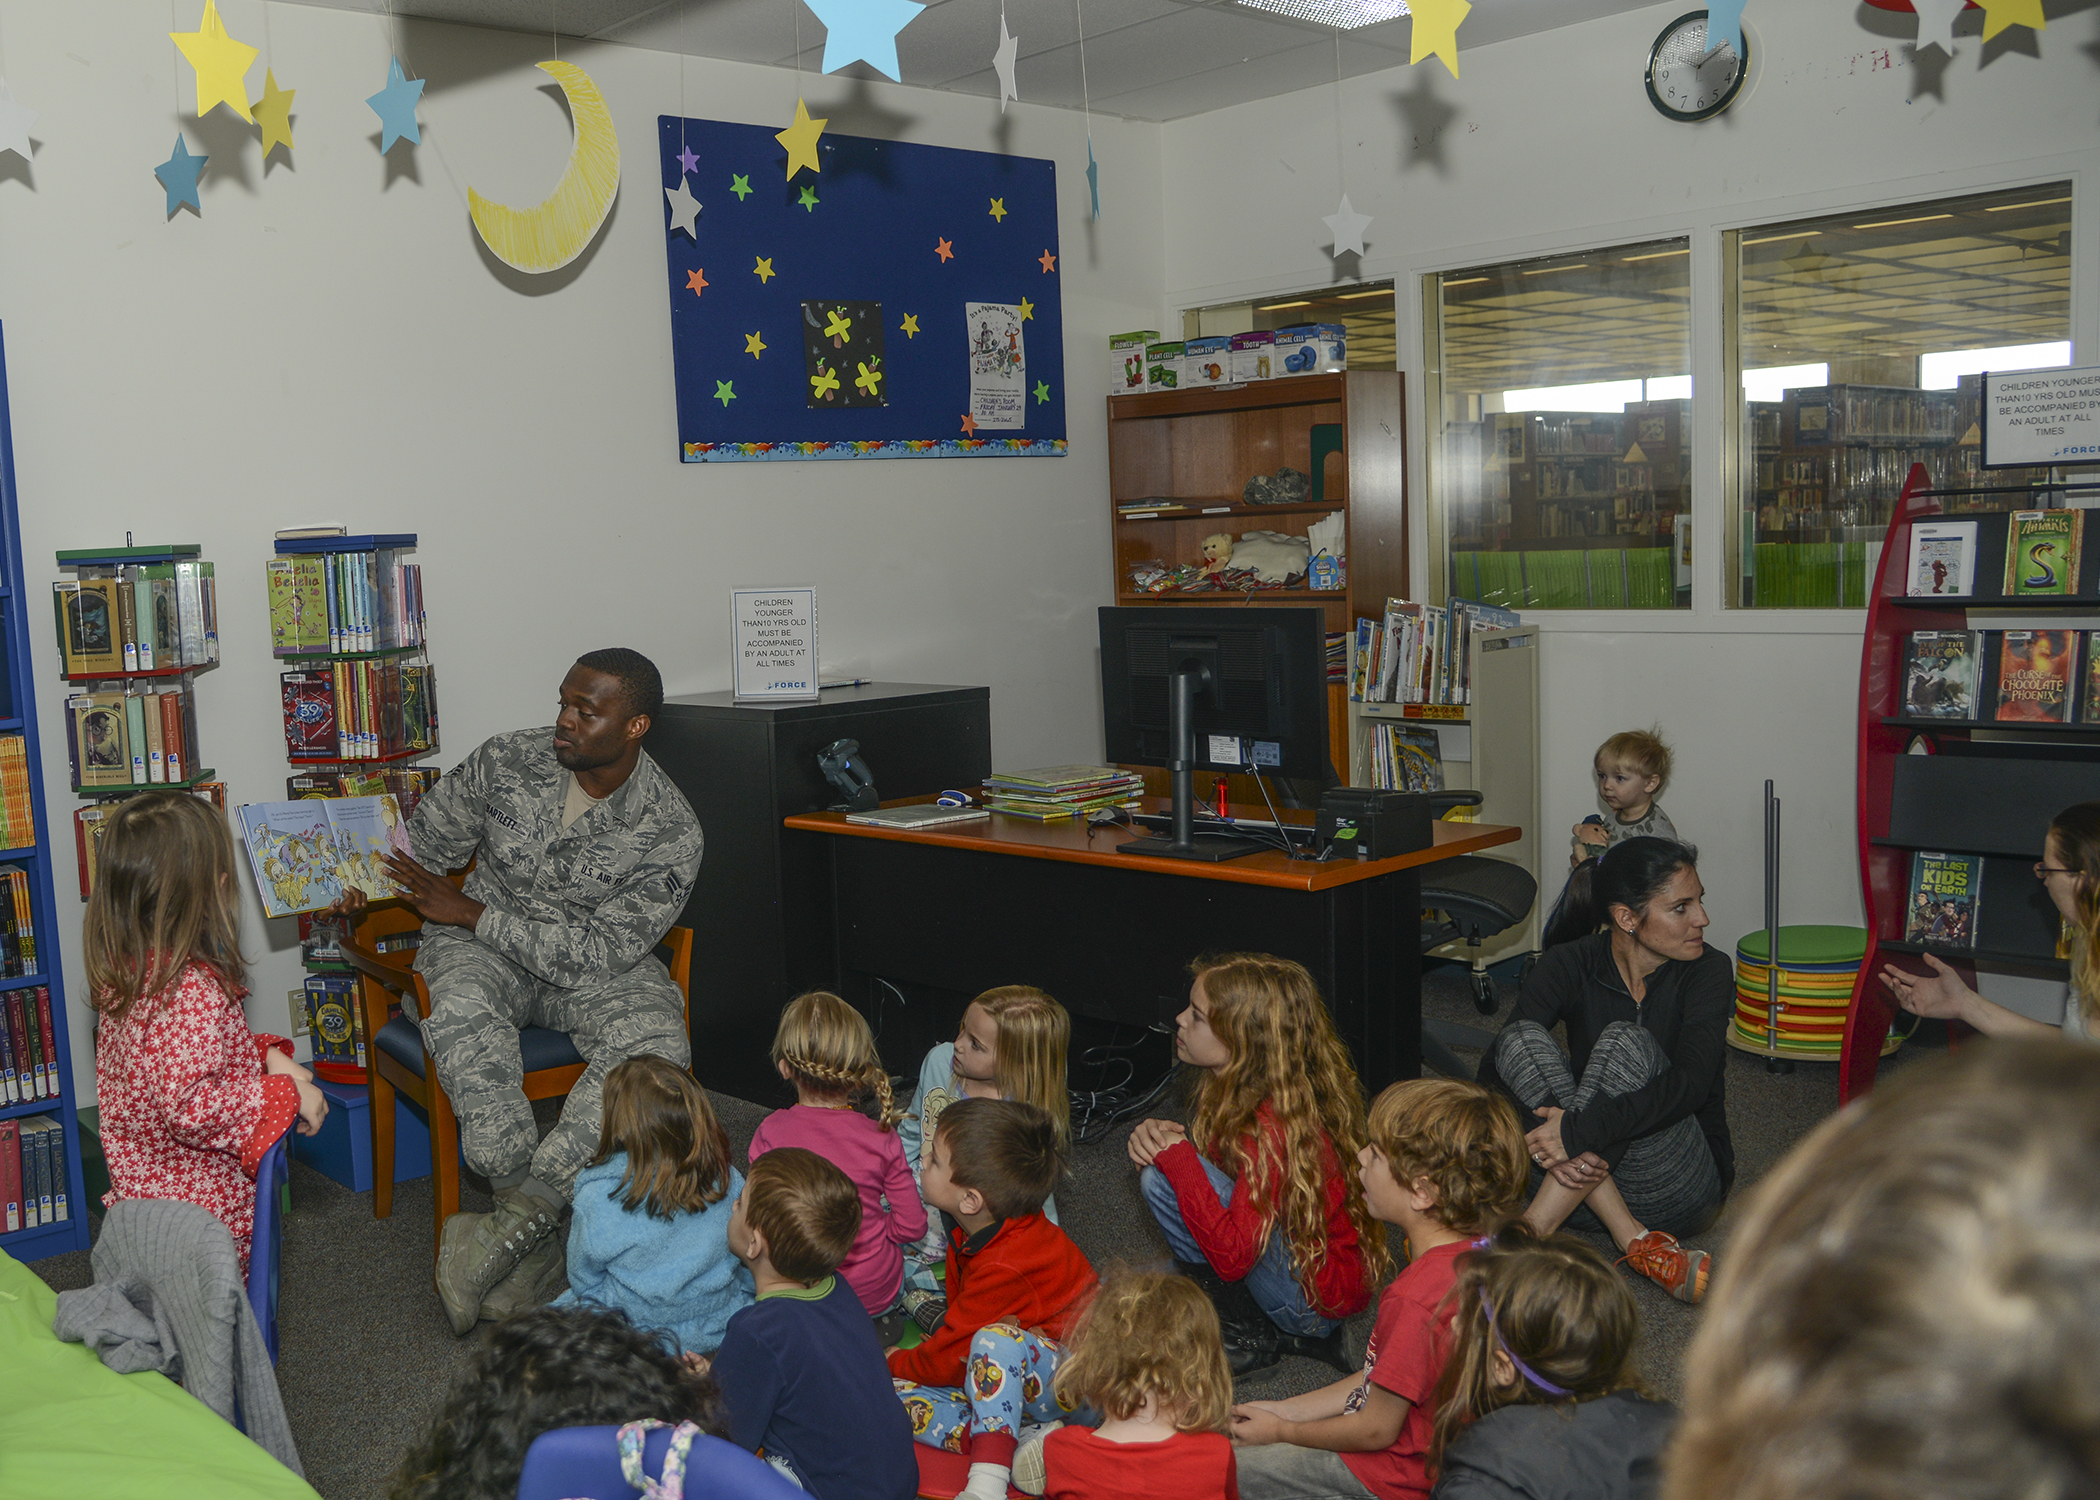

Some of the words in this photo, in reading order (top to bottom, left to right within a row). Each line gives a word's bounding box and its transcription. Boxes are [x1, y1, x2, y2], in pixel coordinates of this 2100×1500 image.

[1730, 52, 1736, 64] 3
[1662, 70, 1669, 82] 9
[1724, 72, 1732, 84] 4
[1668, 86, 1675, 98] 8
[1712, 88, 1718, 102] 5
[1680, 95, 1688, 108] 7
[1696, 96, 1704, 108] 6
[981, 305, 1000, 313] Pajama
[1001, 306, 1018, 322] Party!
[1276, 336, 1293, 344] ANIMAL
[2000, 381, 2048, 391] CHILDREN
[2052, 376, 2100, 387] YOUNGER
[1995, 394, 2031, 403] THAN10
[2034, 392, 2053, 400] YRS
[2056, 390, 2076, 399] OLD
[2079, 388, 2100, 397] MUS
[2000, 407, 2011, 415] BE
[2014, 401, 2086, 414] ACCOMPANIED
[2024, 416, 2056, 425] ADULT
[2058, 414, 2071, 422] AT
[2035, 427, 2064, 436] TIMES
[274, 576, 319, 588] Bedelia
[747, 639, 803, 647] ACCOMPANIED
[1918, 648, 1964, 658] FALCON
[2017, 669, 2044, 680] CURSE
[2002, 679, 2064, 692] CHOCOLATE
[2012, 690, 2056, 703] PHOENIX
[300, 704, 319, 717] 39
[485, 804, 517, 829] BARTLETT
[1924, 860, 1942, 869] THE
[1943, 861, 1969, 871] LAST
[581, 864, 594, 879] U.S.
[596, 872, 612, 885] AIR
[1923, 869, 1968, 886] KIDS
[1935, 884, 1966, 896] EARTH
[326, 1016, 343, 1028] 39
[54, 1151, 64, 1194] ERAGO
